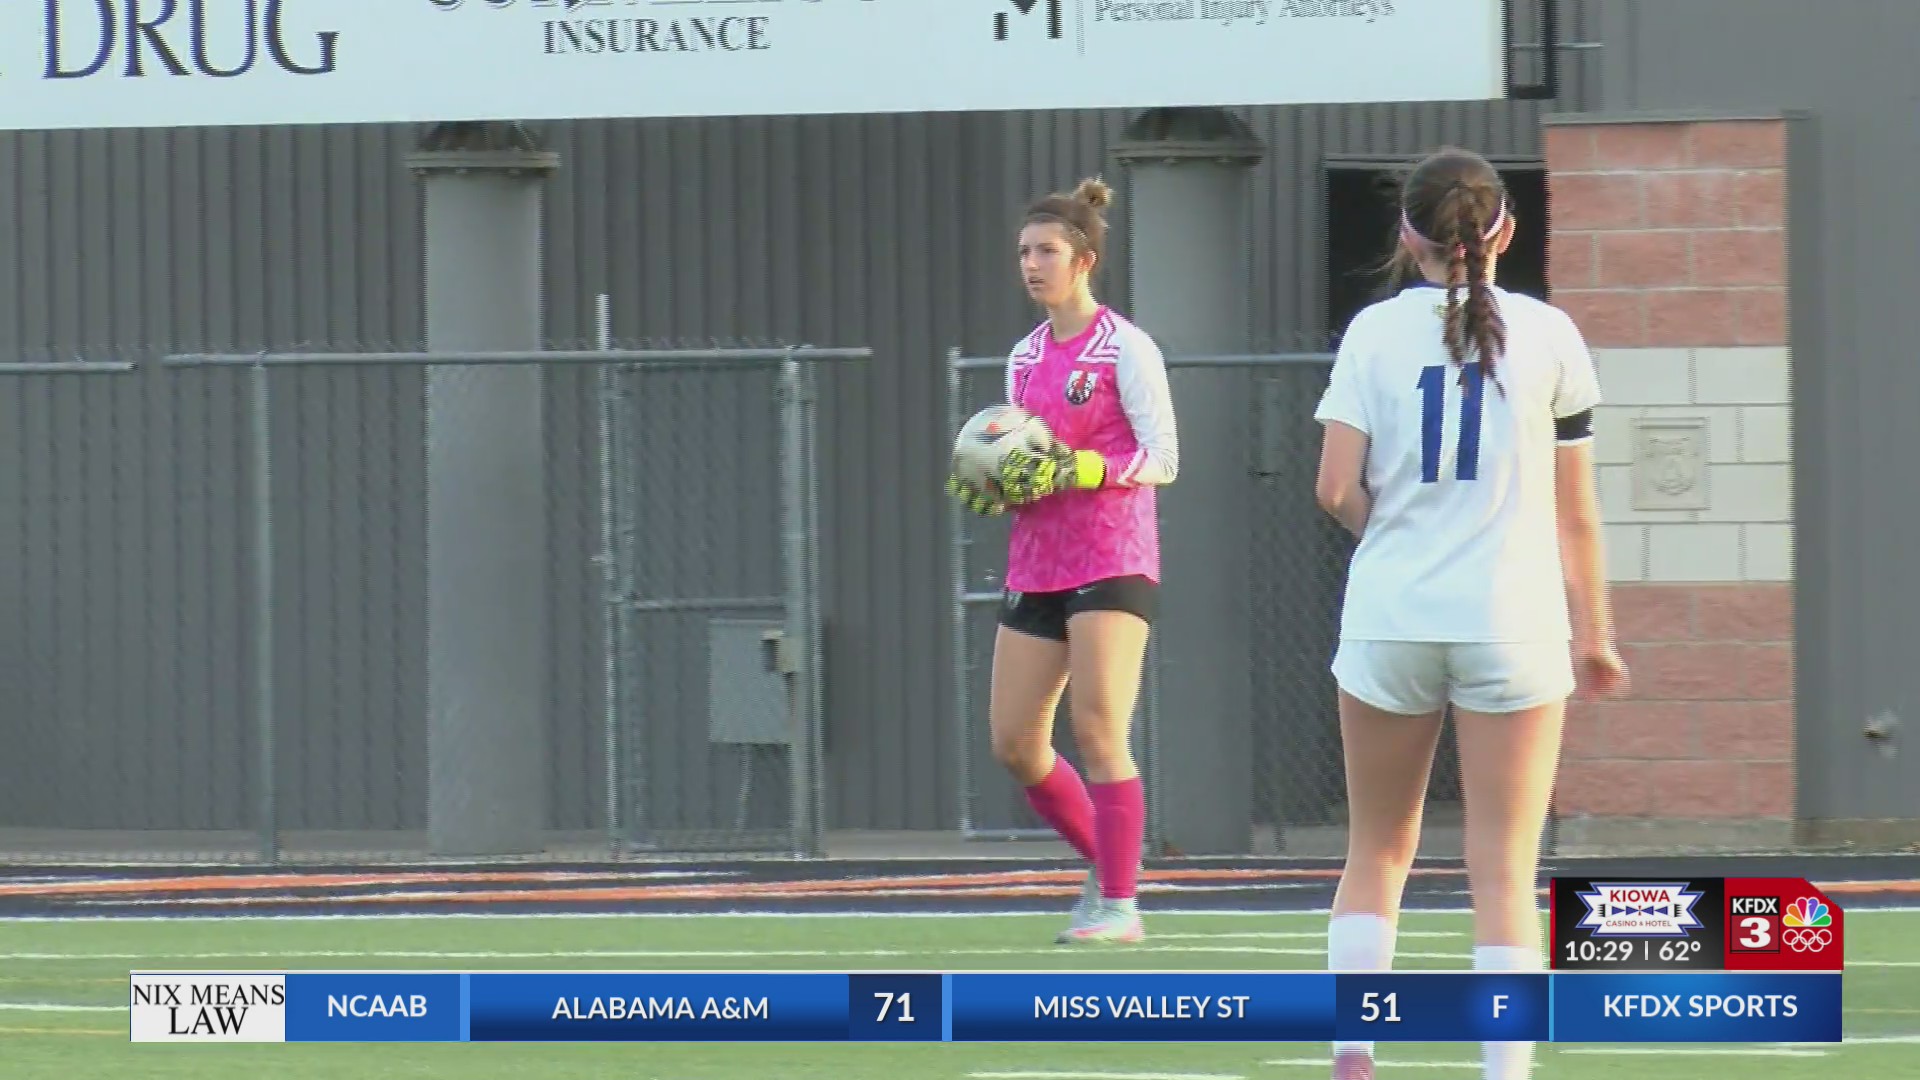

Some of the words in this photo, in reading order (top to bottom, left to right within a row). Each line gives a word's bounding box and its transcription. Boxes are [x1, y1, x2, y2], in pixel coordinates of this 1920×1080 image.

[42, 0, 340, 79] DRUG
[543, 16, 771, 54] INSURANCE
[1095, 0, 1194, 22] Personal
[1199, 0, 1271, 26] Injury
[1416, 363, 1485, 483] 11
